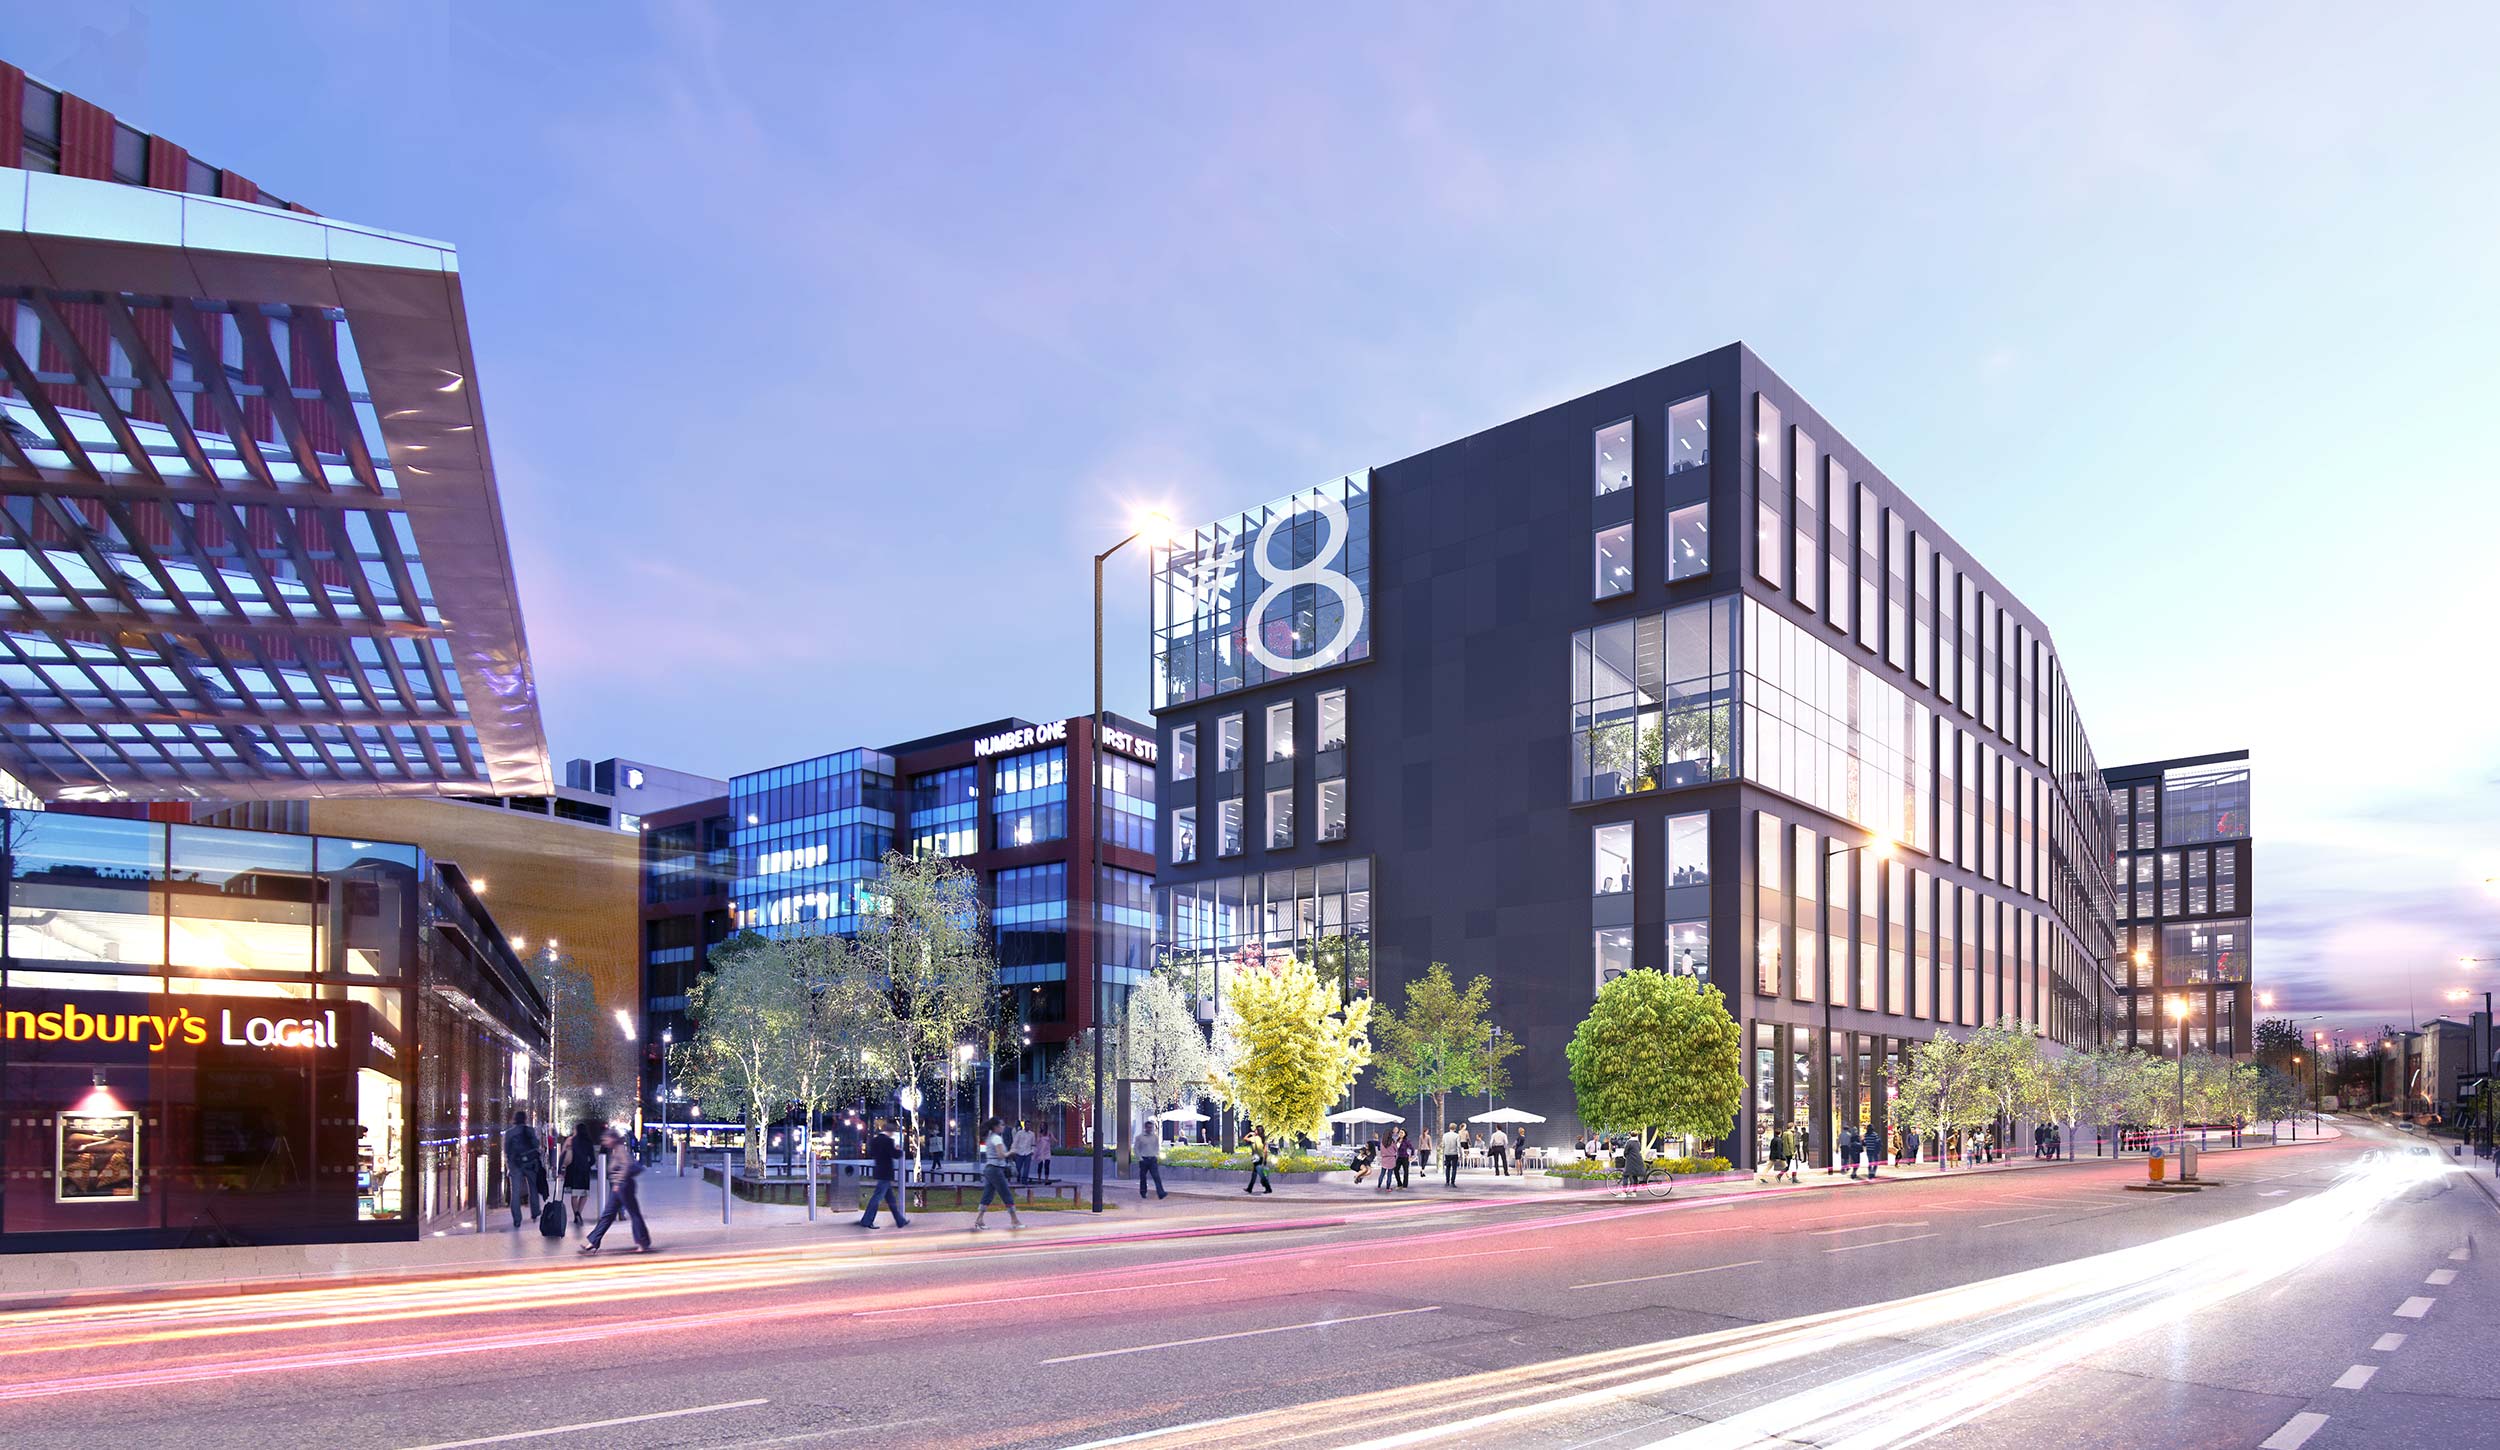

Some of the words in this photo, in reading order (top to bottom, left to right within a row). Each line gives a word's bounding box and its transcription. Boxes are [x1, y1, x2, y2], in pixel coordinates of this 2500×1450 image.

[1183, 495, 1364, 673] #8
[975, 728, 1034, 757] NUMBER
[1036, 720, 1067, 743] ONE
[1093, 722, 1133, 752] IRST
[0, 1003, 207, 1051] nsbury's
[221, 1009, 338, 1048] Local
